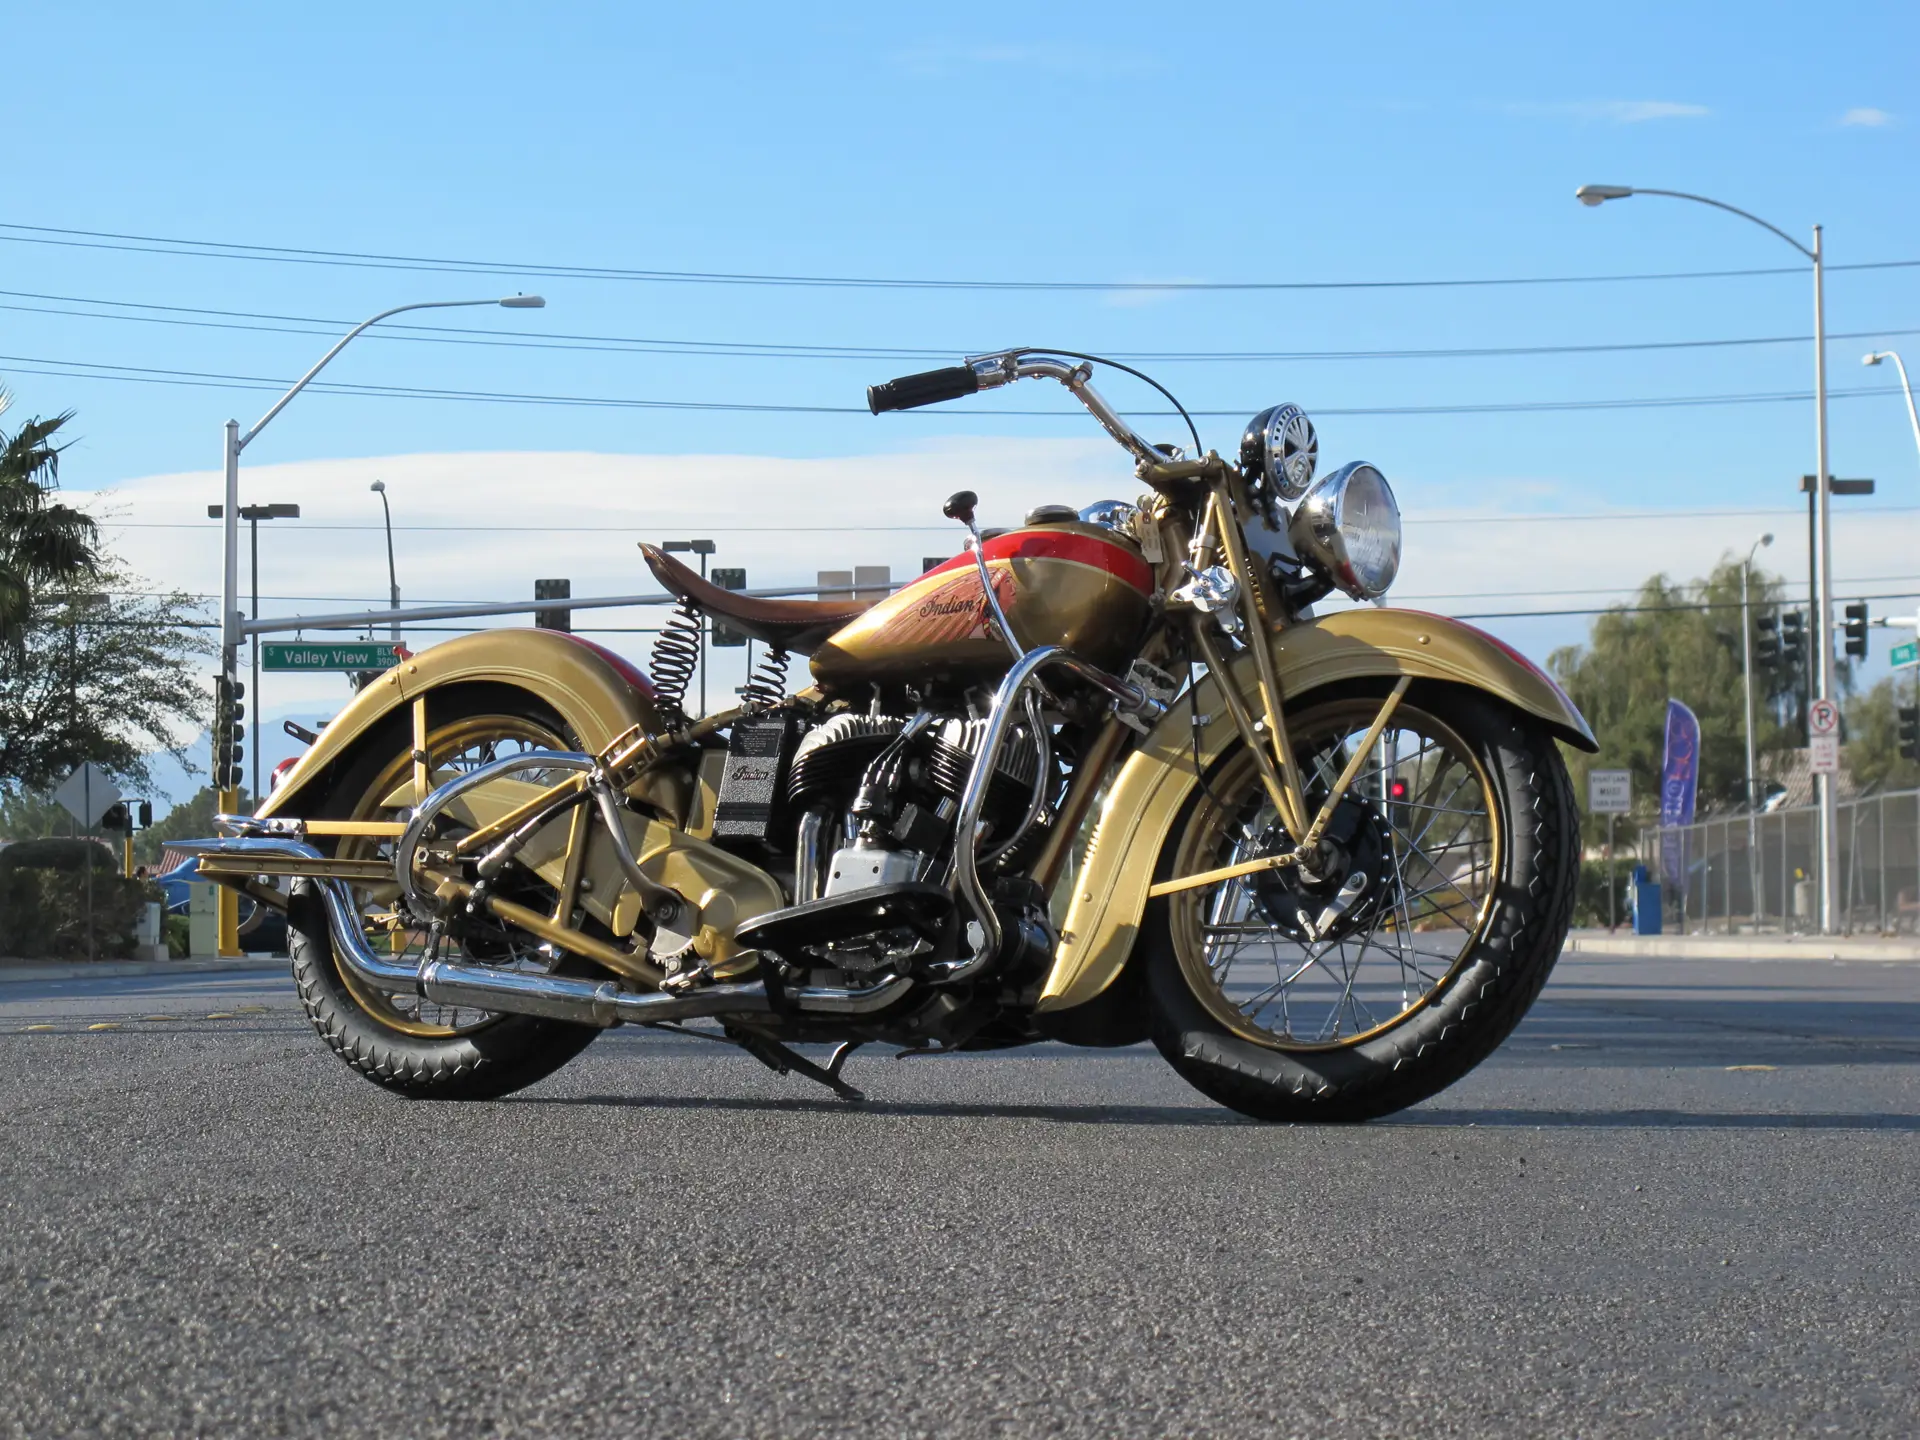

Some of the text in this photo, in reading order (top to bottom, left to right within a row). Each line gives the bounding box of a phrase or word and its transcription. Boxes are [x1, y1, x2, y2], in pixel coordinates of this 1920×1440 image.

[920, 594, 975, 617] Indian
[268, 647, 369, 667] S Valley View
[376, 647, 396, 656] BLV
[376, 657, 398, 667] 3900
